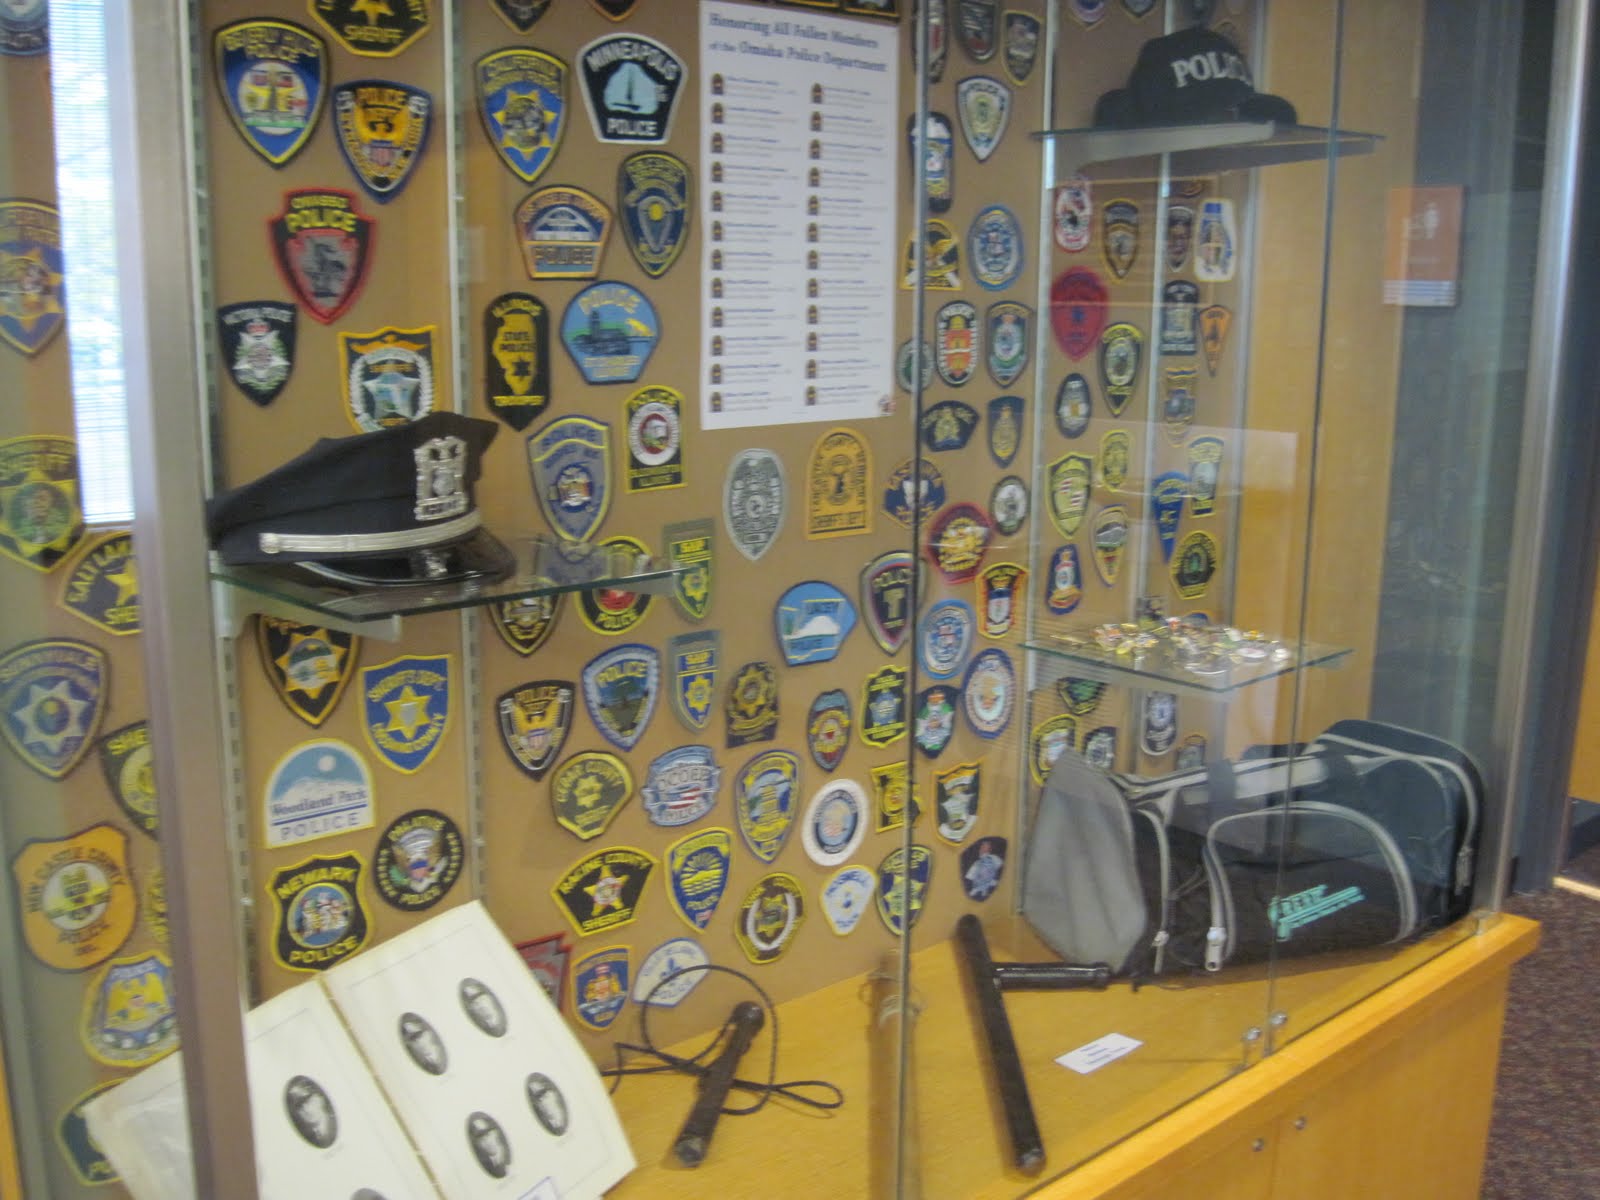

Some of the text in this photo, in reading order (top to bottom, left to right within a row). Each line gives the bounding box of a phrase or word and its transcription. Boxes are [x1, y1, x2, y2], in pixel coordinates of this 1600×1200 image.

[709, 12, 878, 48] Honoring All Fallen Members
[739, 41, 784, 58] Omaha
[787, 46, 821, 63] Police
[823, 51, 888, 72] Department
[606, 117, 658, 137] POLICE
[285, 208, 358, 233] POLICE
[596, 660, 648, 684] POLICE
[337, 788, 368, 802] Park
[280, 812, 360, 842] POLICE
[277, 866, 358, 899] NEWARK
[582, 907, 633, 932] SHERIFF
[289, 936, 359, 964] POLICE
